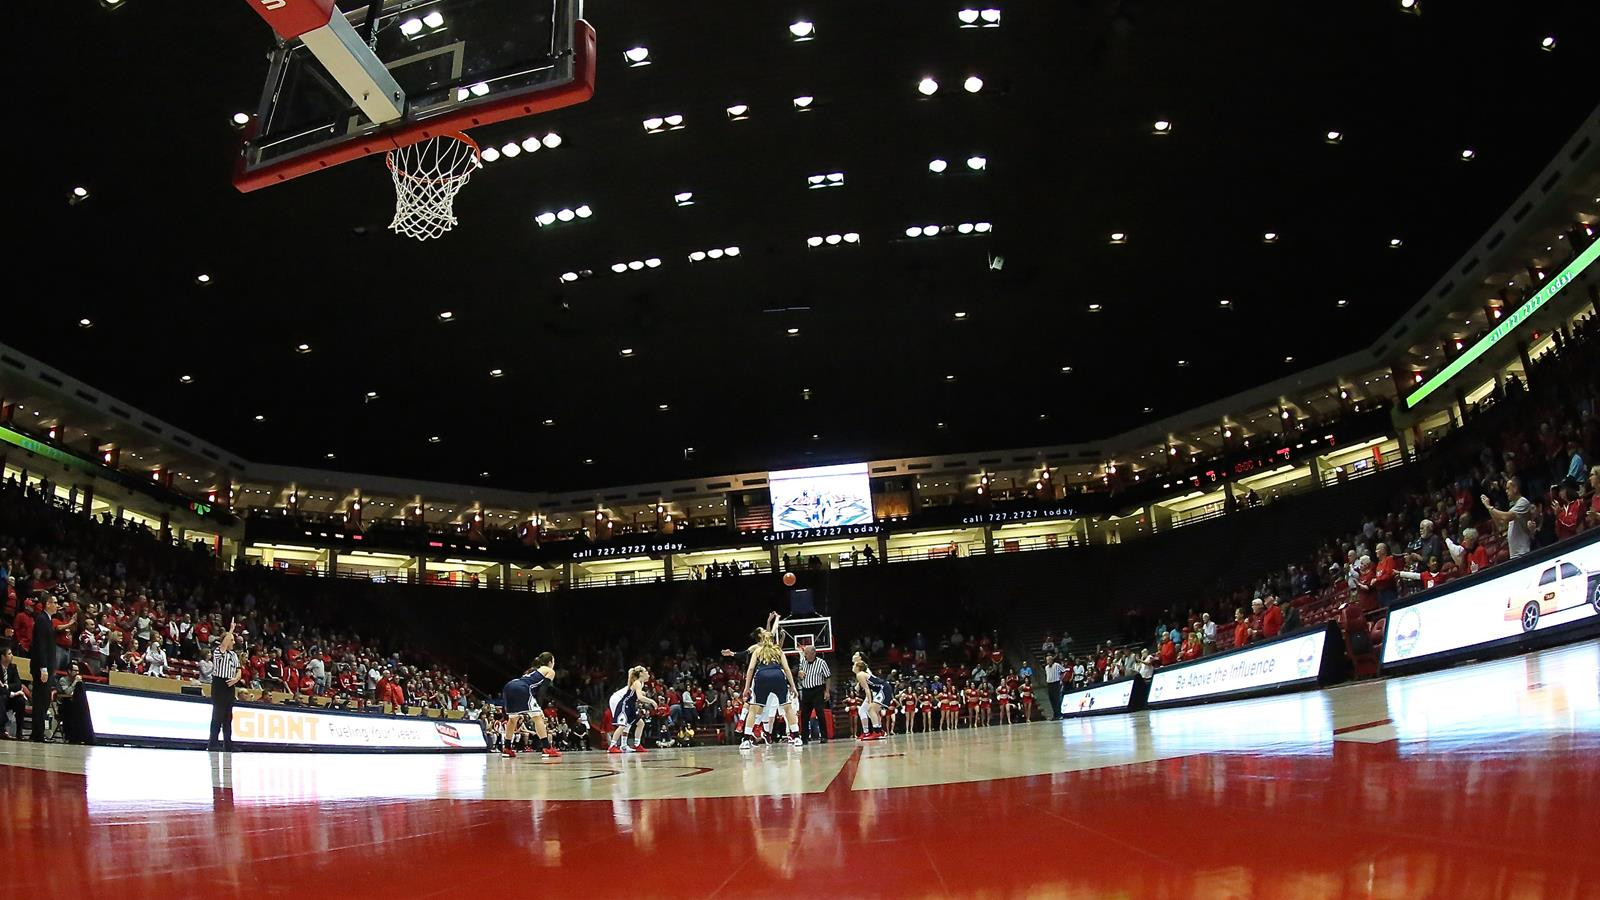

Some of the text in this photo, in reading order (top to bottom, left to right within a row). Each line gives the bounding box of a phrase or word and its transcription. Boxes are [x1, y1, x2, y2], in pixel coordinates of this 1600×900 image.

[963, 508, 1077, 524] call 727.2727 today.
[763, 525, 884, 541] call 727.2727 today.
[573, 542, 687, 558] call 727.2727 today.
[1176, 658, 1275, 690] Be Above the Influence
[232, 711, 319, 741] GIANT
